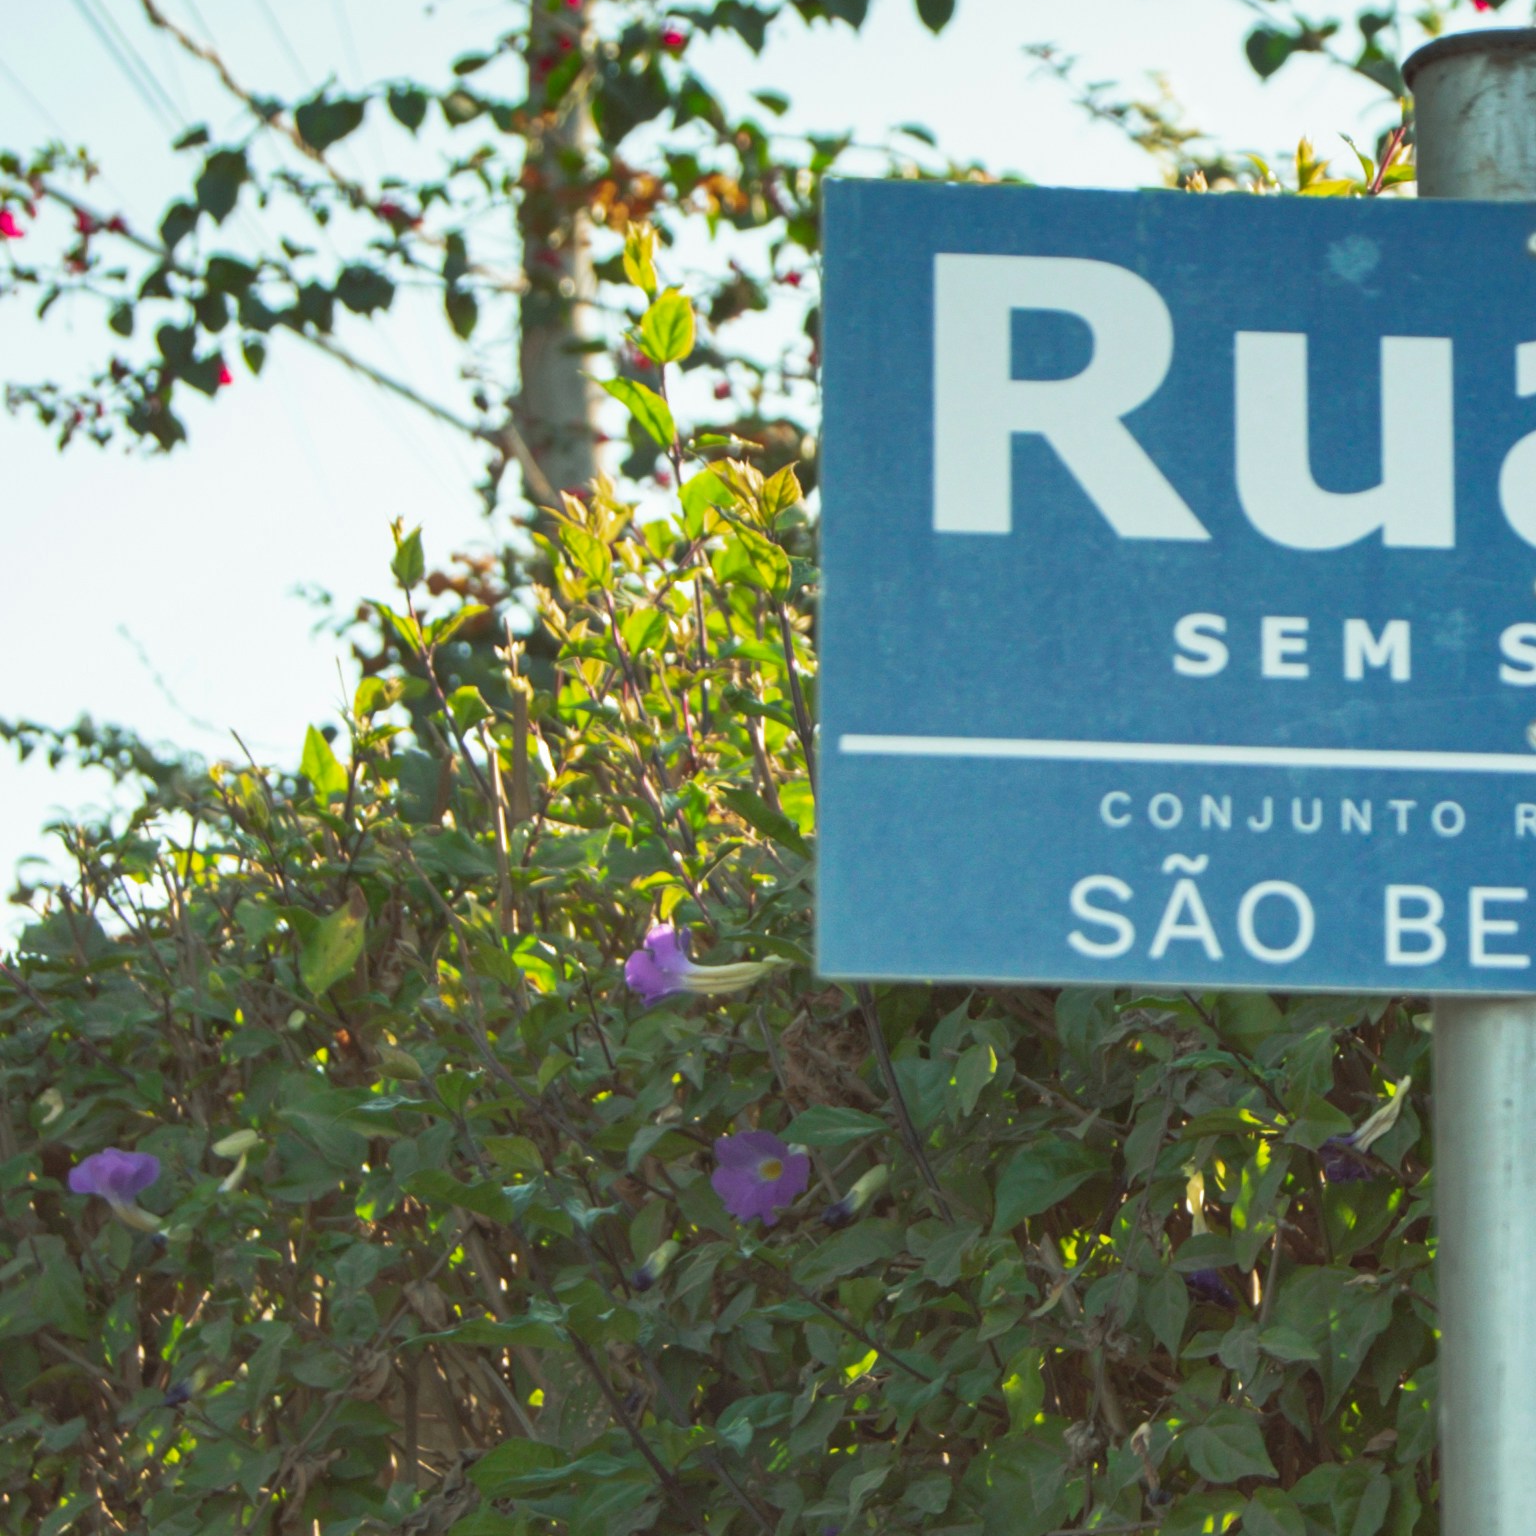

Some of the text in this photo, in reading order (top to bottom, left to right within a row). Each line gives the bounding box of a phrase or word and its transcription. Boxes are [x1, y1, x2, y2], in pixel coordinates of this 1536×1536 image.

[1174, 613, 1410, 681] SEM
[1100, 790, 1466, 836] CONJUNTO
[1067, 853, 1314, 963] SÃO
